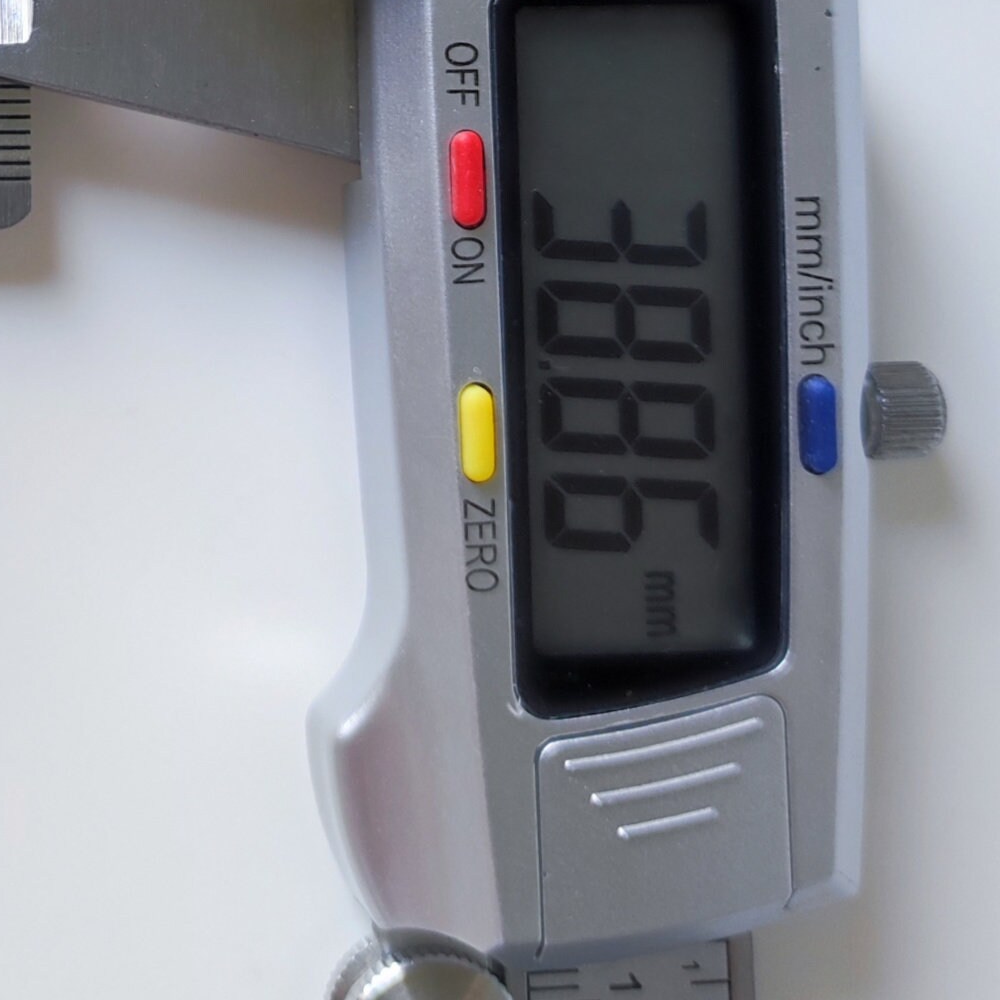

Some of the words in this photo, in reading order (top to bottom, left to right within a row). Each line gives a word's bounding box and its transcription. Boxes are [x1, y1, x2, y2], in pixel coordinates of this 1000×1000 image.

[443, 41, 480, 108] OFF
[450, 236, 485, 286] ON
[794, 195, 835, 366] mm/inch
[531, 188, 721, 554] 38.86
[643, 569, 679, 638] mm
[463, 497, 500, 593] ZERO
